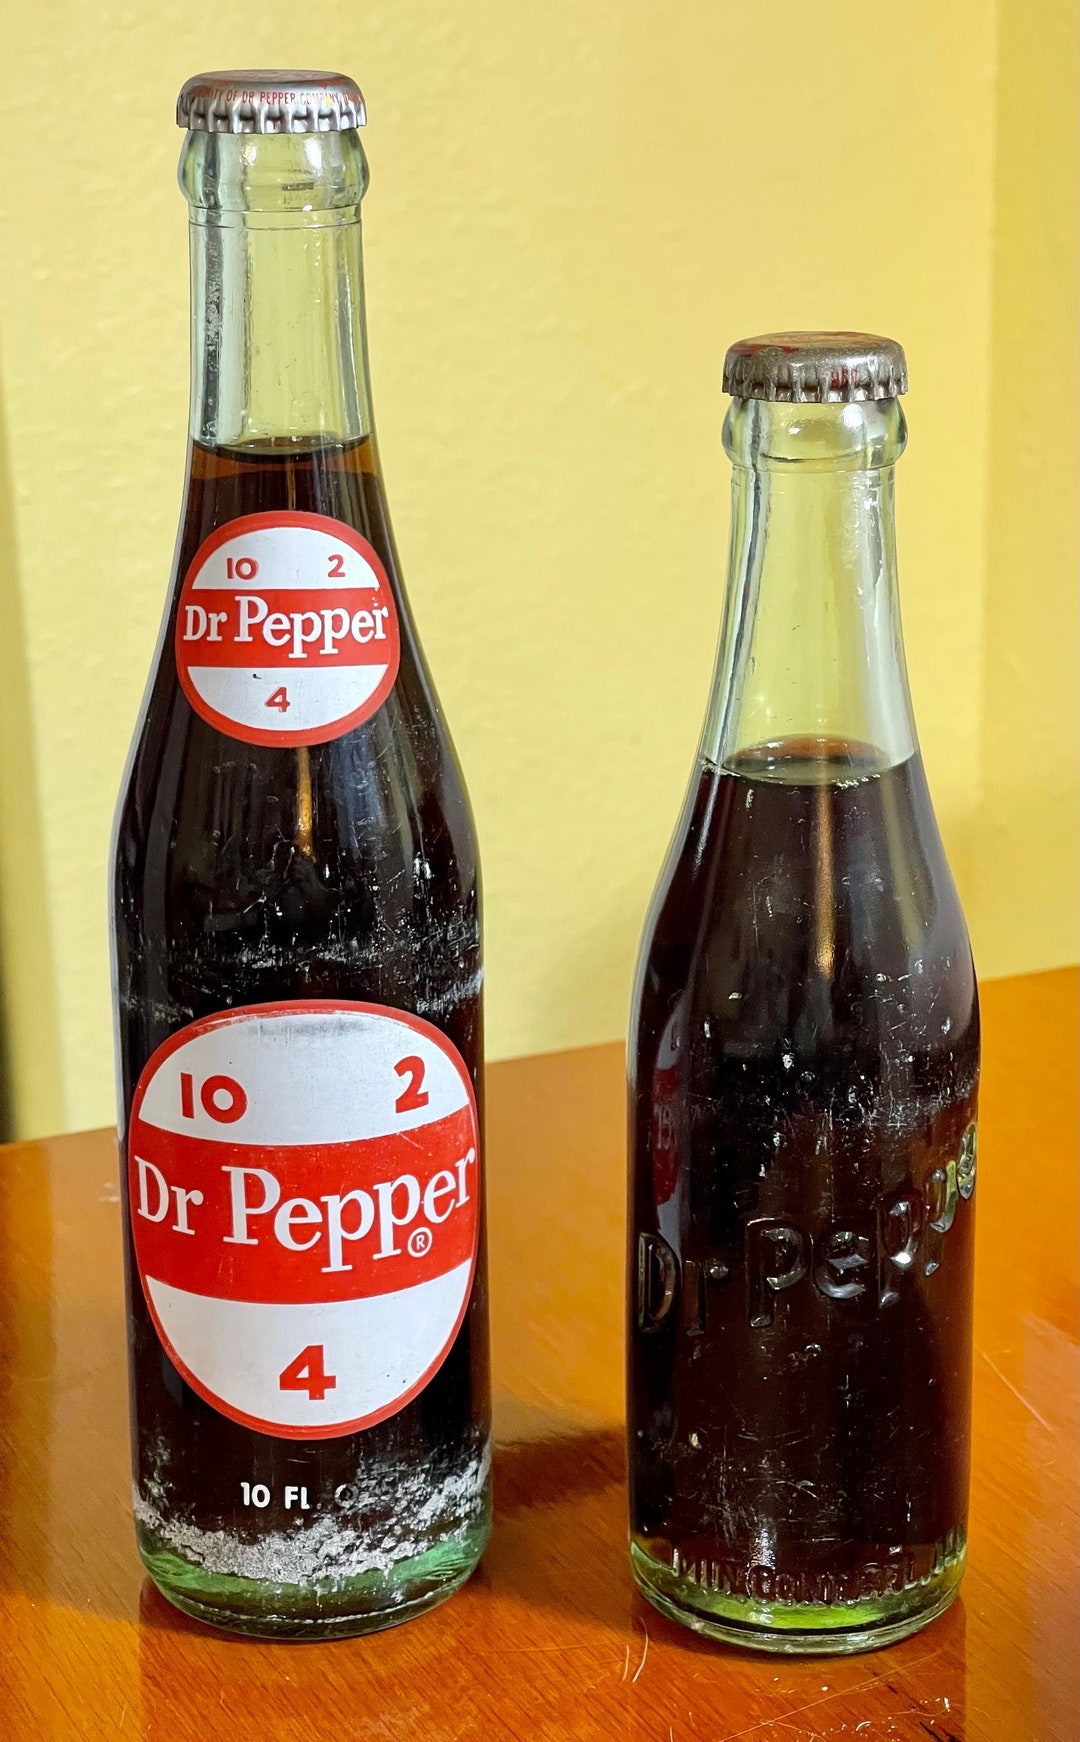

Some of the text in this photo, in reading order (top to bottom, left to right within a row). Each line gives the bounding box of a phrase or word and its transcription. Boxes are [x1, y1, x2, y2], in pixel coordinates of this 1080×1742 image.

[226, 89, 238, 101] OF
[242, 90, 255, 103] DR
[260, 91, 296, 105] PEPPER
[226, 554, 346, 580] 10 2
[183, 595, 389, 659] Dr Pepper
[264, 686, 291, 713] 4
[180, 1055, 430, 1124] 10 2
[134, 1147, 476, 1273] Dr Pepper
[745, 1122, 976, 1329] Peppe
[279, 1344, 337, 1401] 4
[240, 1481, 271, 1509] 10
